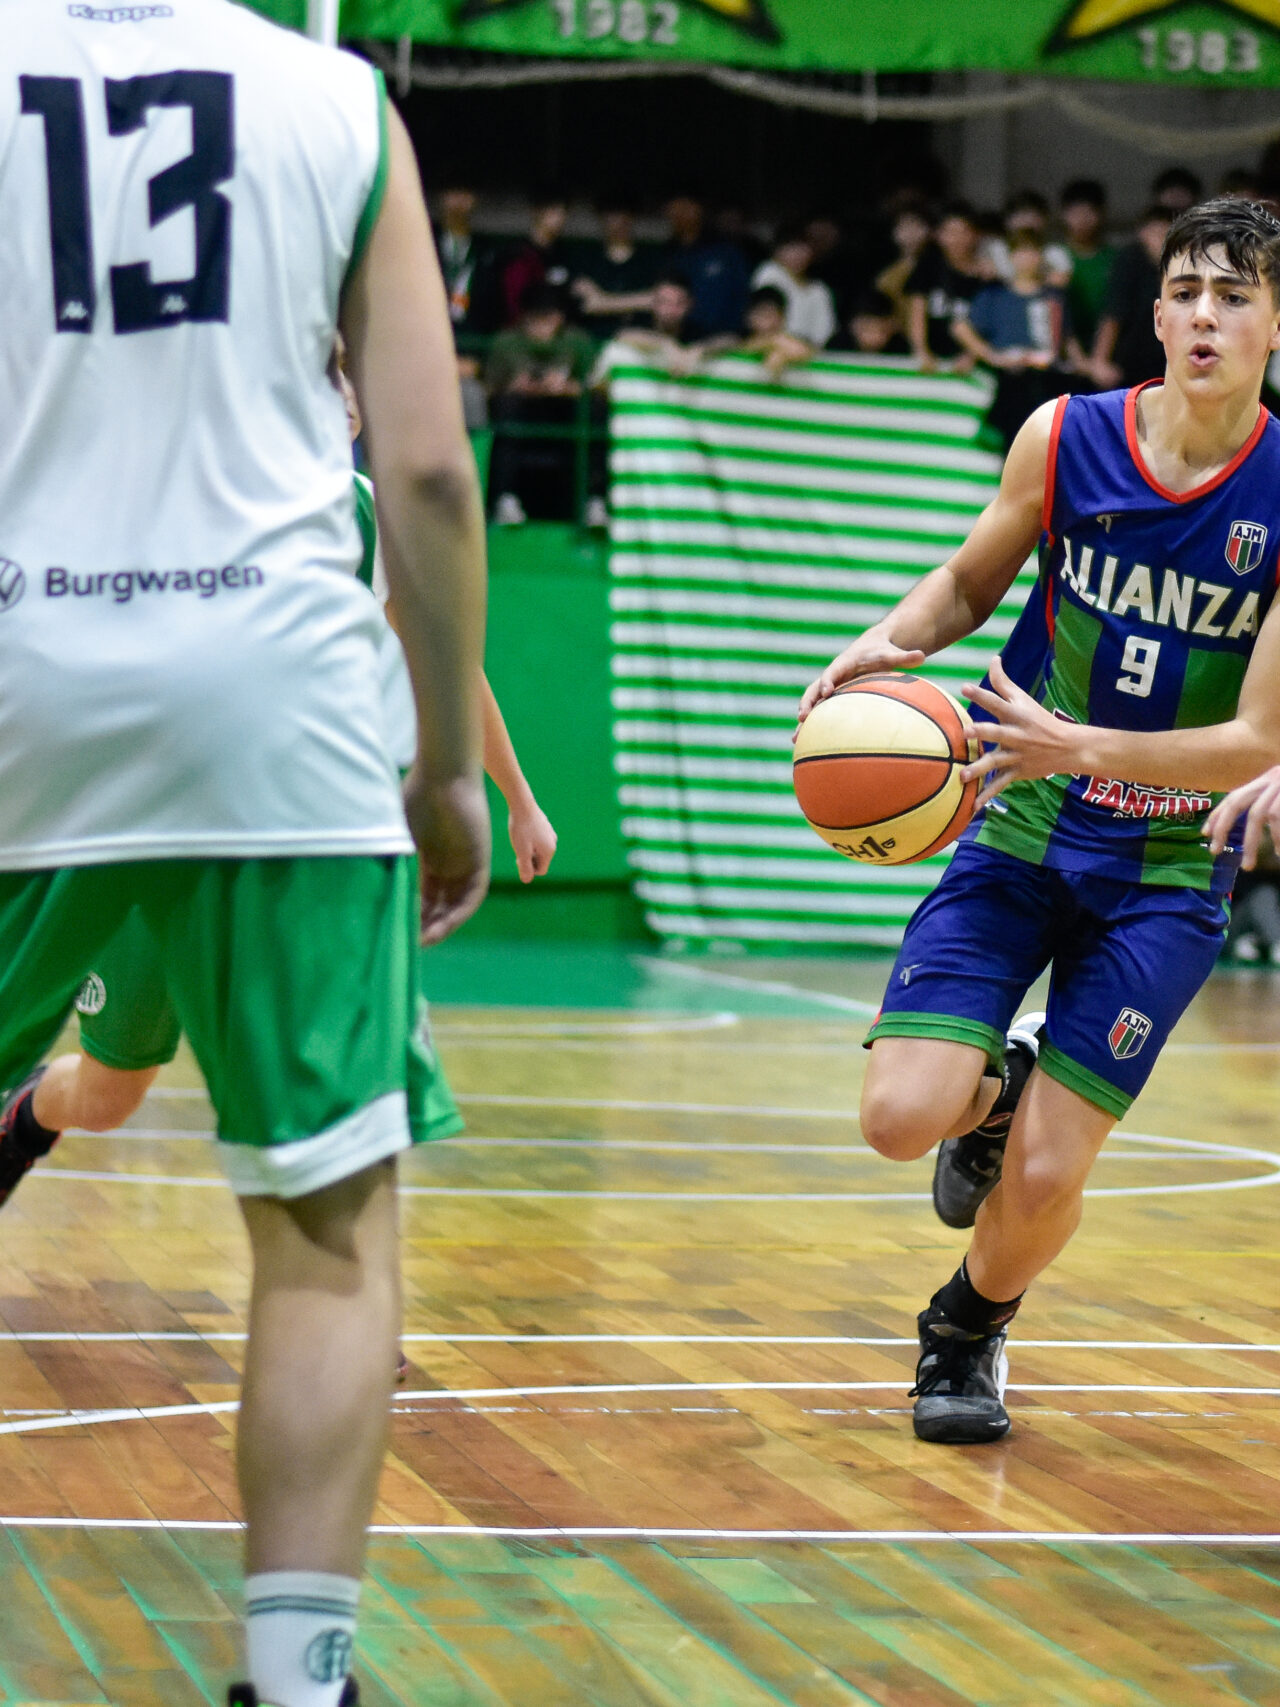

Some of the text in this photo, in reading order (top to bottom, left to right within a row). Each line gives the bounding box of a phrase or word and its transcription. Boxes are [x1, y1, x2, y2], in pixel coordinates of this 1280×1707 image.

[67, 4, 174, 23] Kappa
[552, 0, 679, 44] 1982
[1138, 28, 1260, 73] 1983
[18, 69, 235, 334] 13
[1234, 525, 1263, 542] AJM
[45, 565, 264, 603] Burgwagen
[1060, 535, 1260, 640] ALIANZA
[1115, 635, 1161, 698] 9
[1122, 1013, 1149, 1035] AJM
